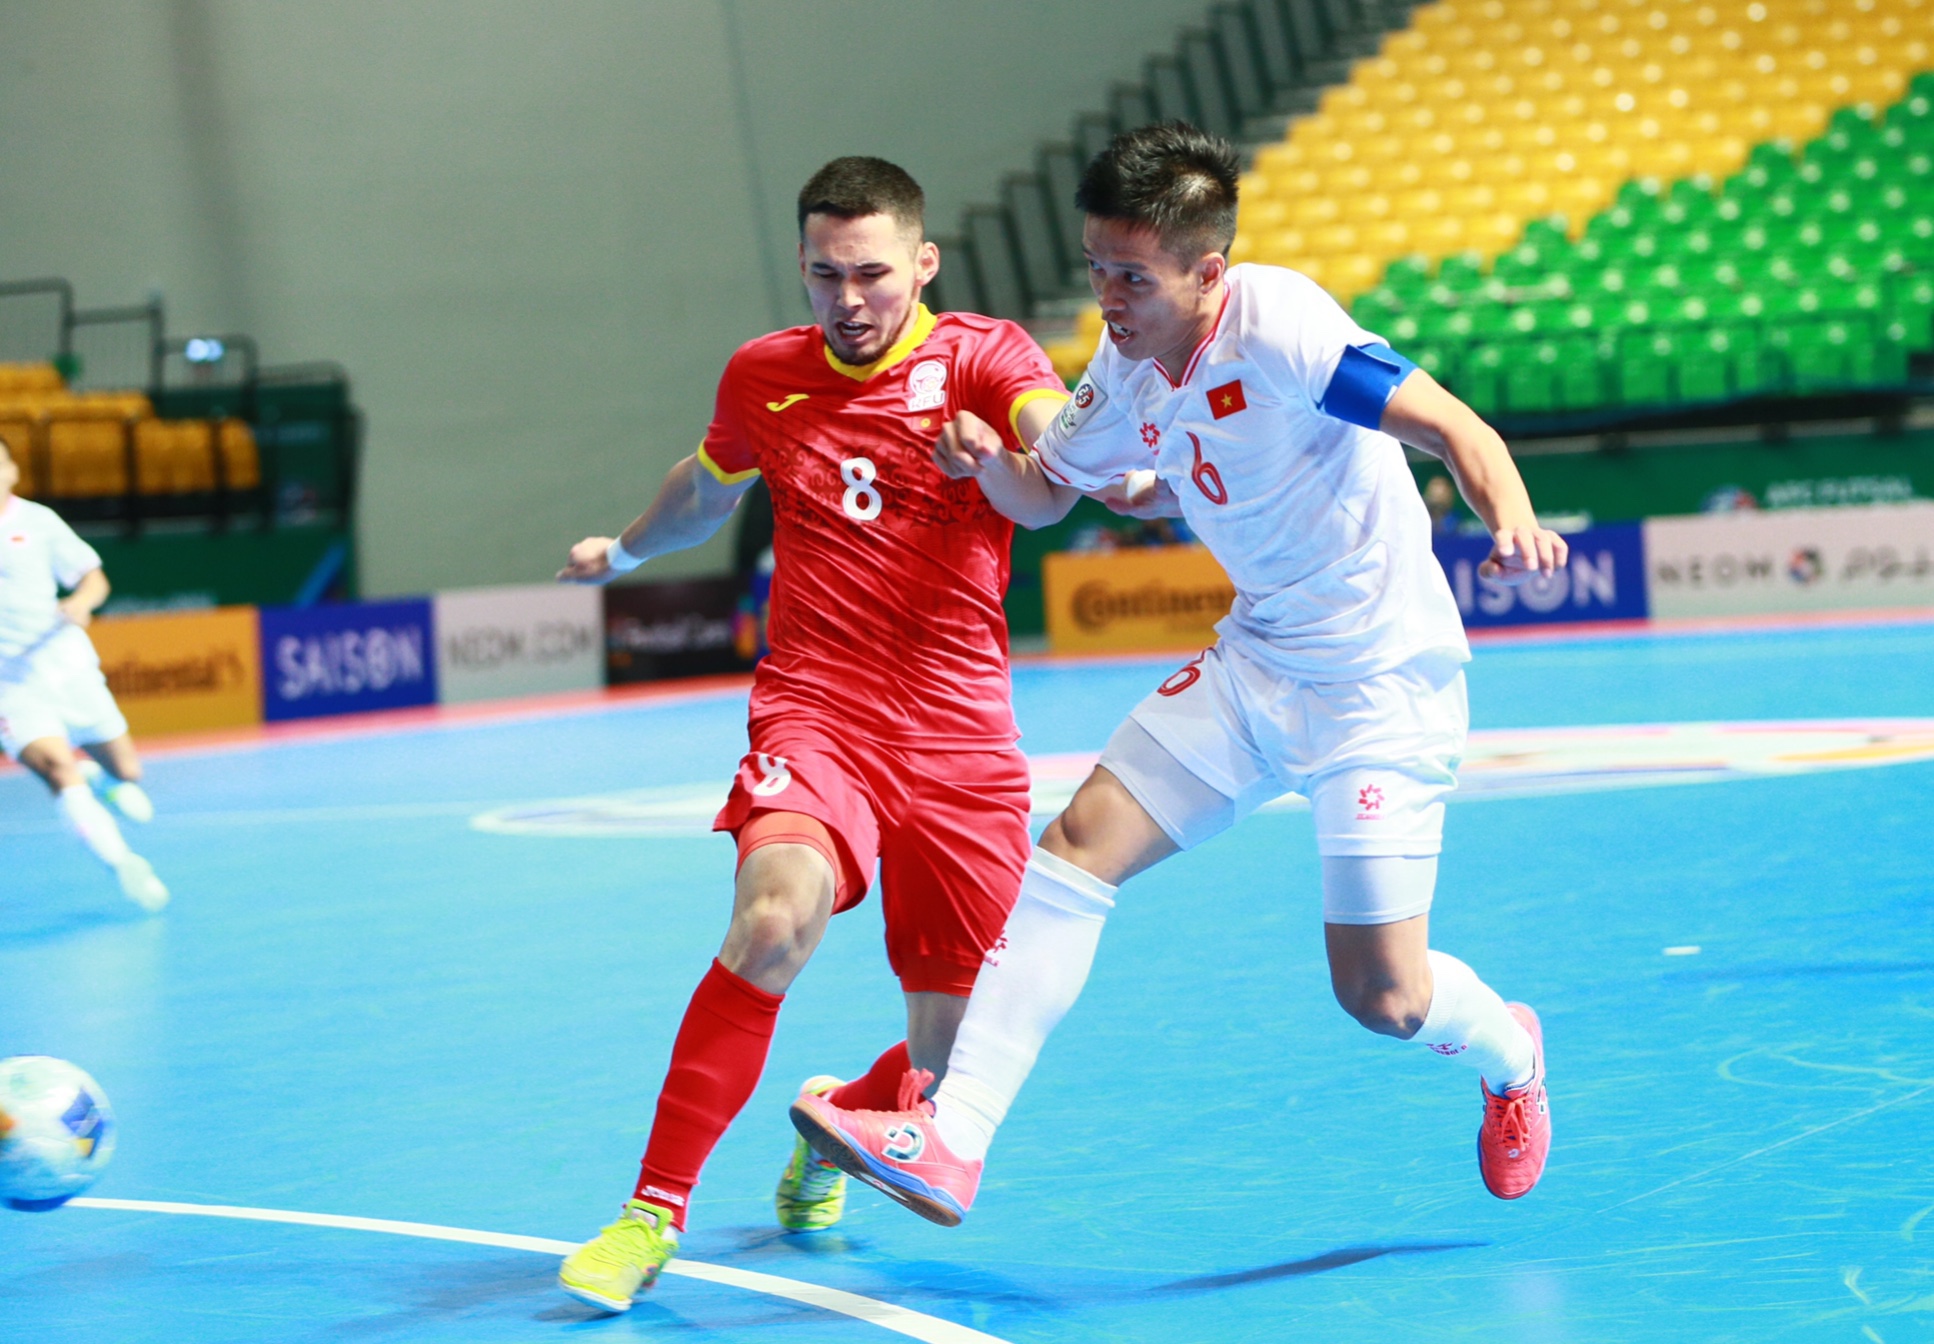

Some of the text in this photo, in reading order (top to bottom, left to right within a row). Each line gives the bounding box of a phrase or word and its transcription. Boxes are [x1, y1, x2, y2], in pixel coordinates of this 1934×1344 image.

[841, 456, 882, 521] 8
[1185, 431, 1228, 505] 6
[1454, 551, 1616, 616] ISON
[276, 626, 423, 700] SAISON
[1157, 646, 1221, 697] 6
[752, 753, 791, 797] 8
